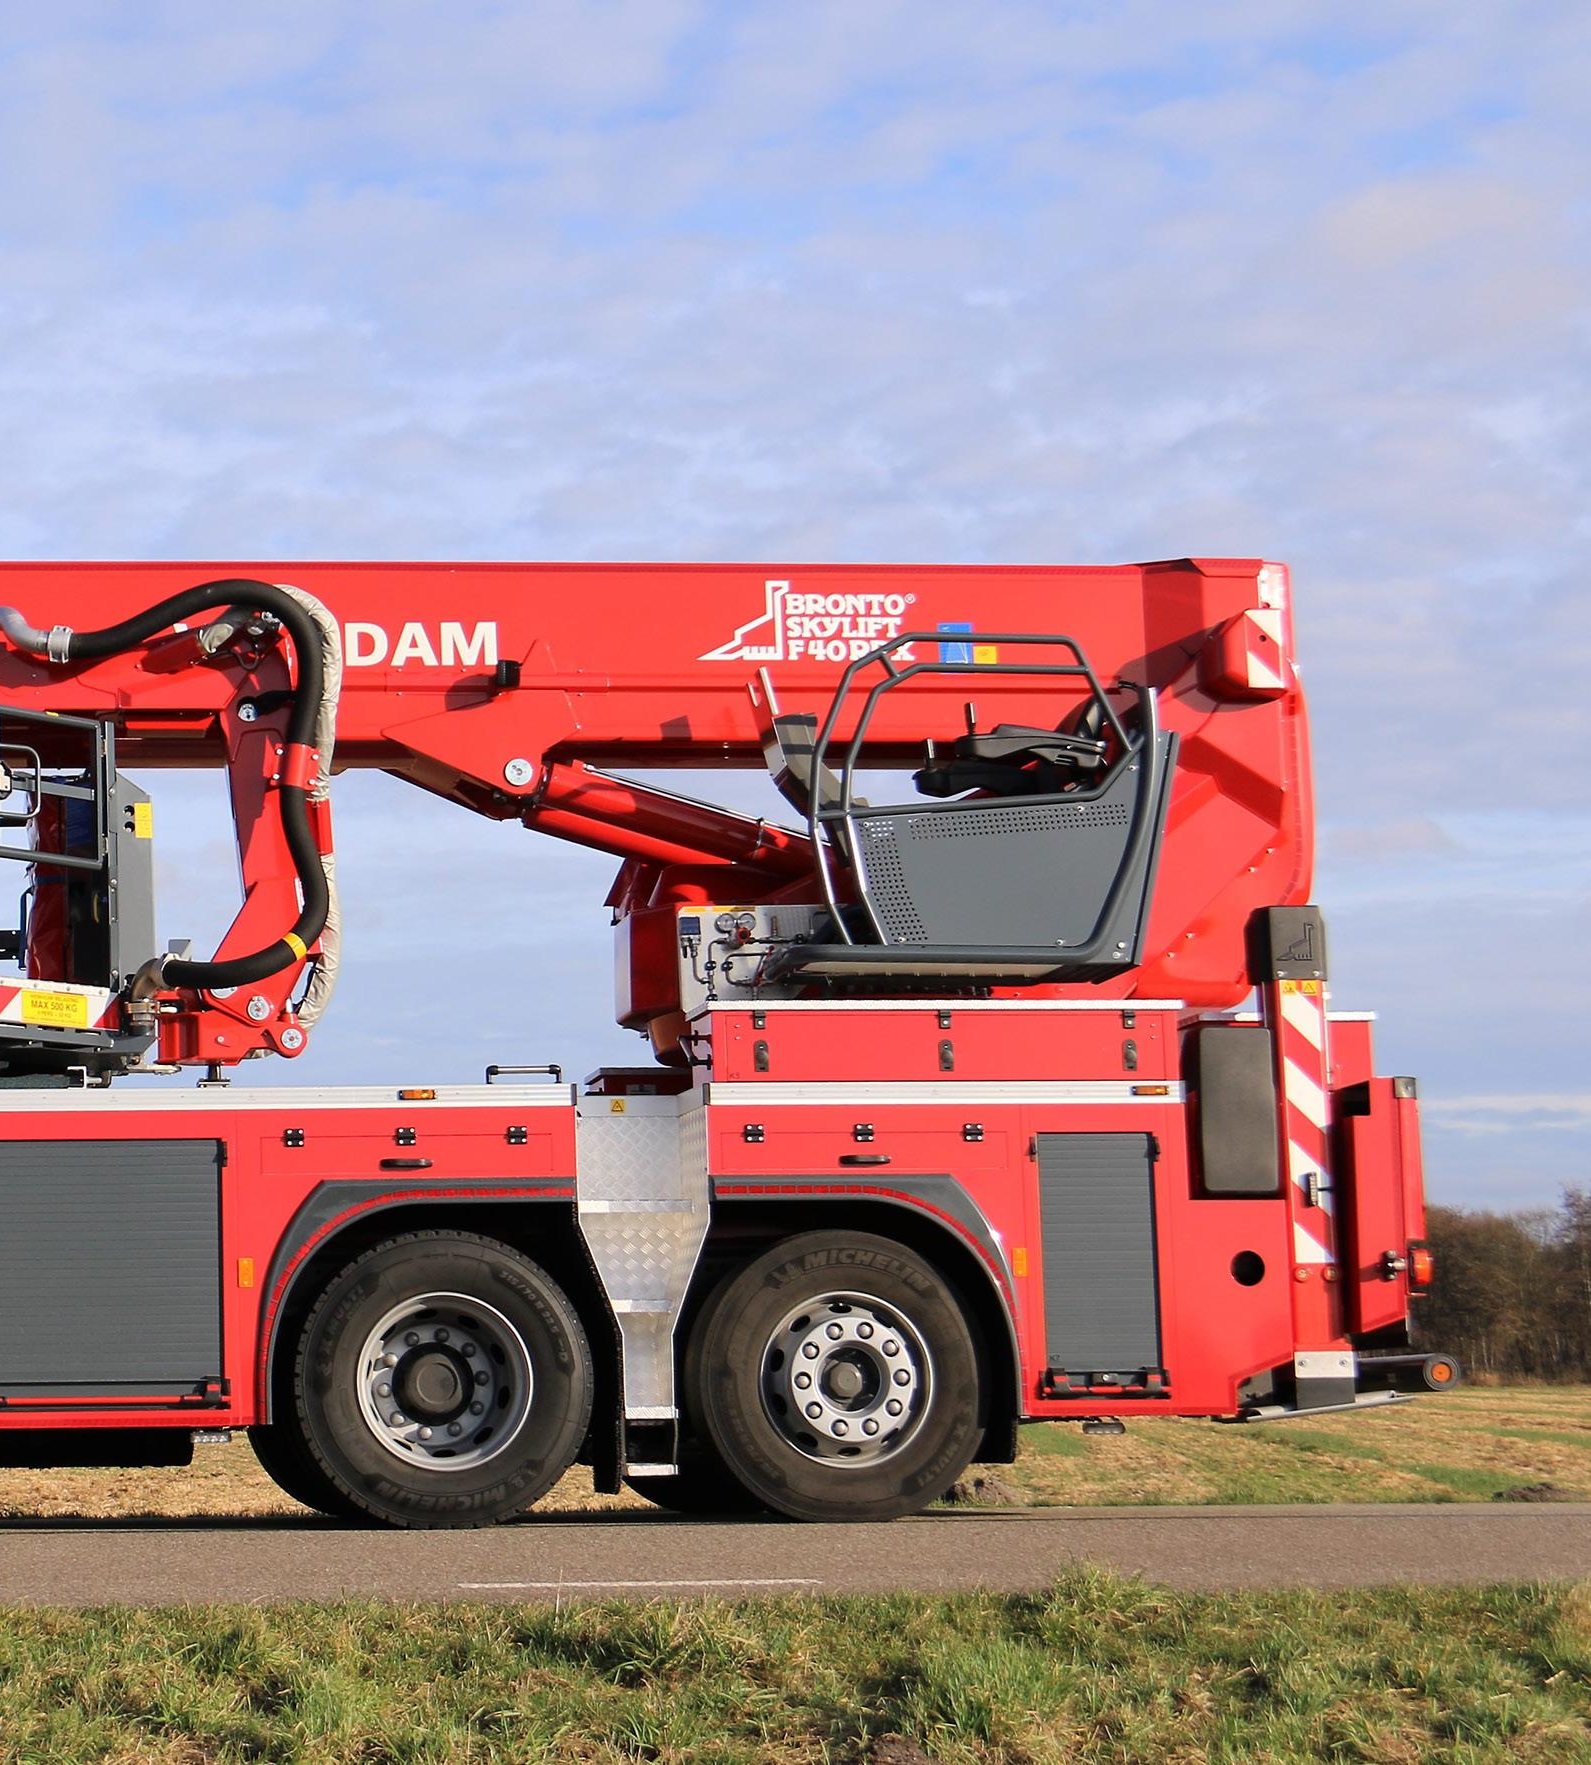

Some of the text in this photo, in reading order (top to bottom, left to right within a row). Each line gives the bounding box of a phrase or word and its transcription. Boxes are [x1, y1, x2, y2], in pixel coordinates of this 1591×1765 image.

[785, 594, 906, 615] BRONTO
[785, 616, 902, 638] SKYLIFT
[31, 1000, 78, 1013] MAX 500 KG
[804, 1248, 931, 1291] MICHELIN
[377, 1480, 507, 1511] MICHELIN
